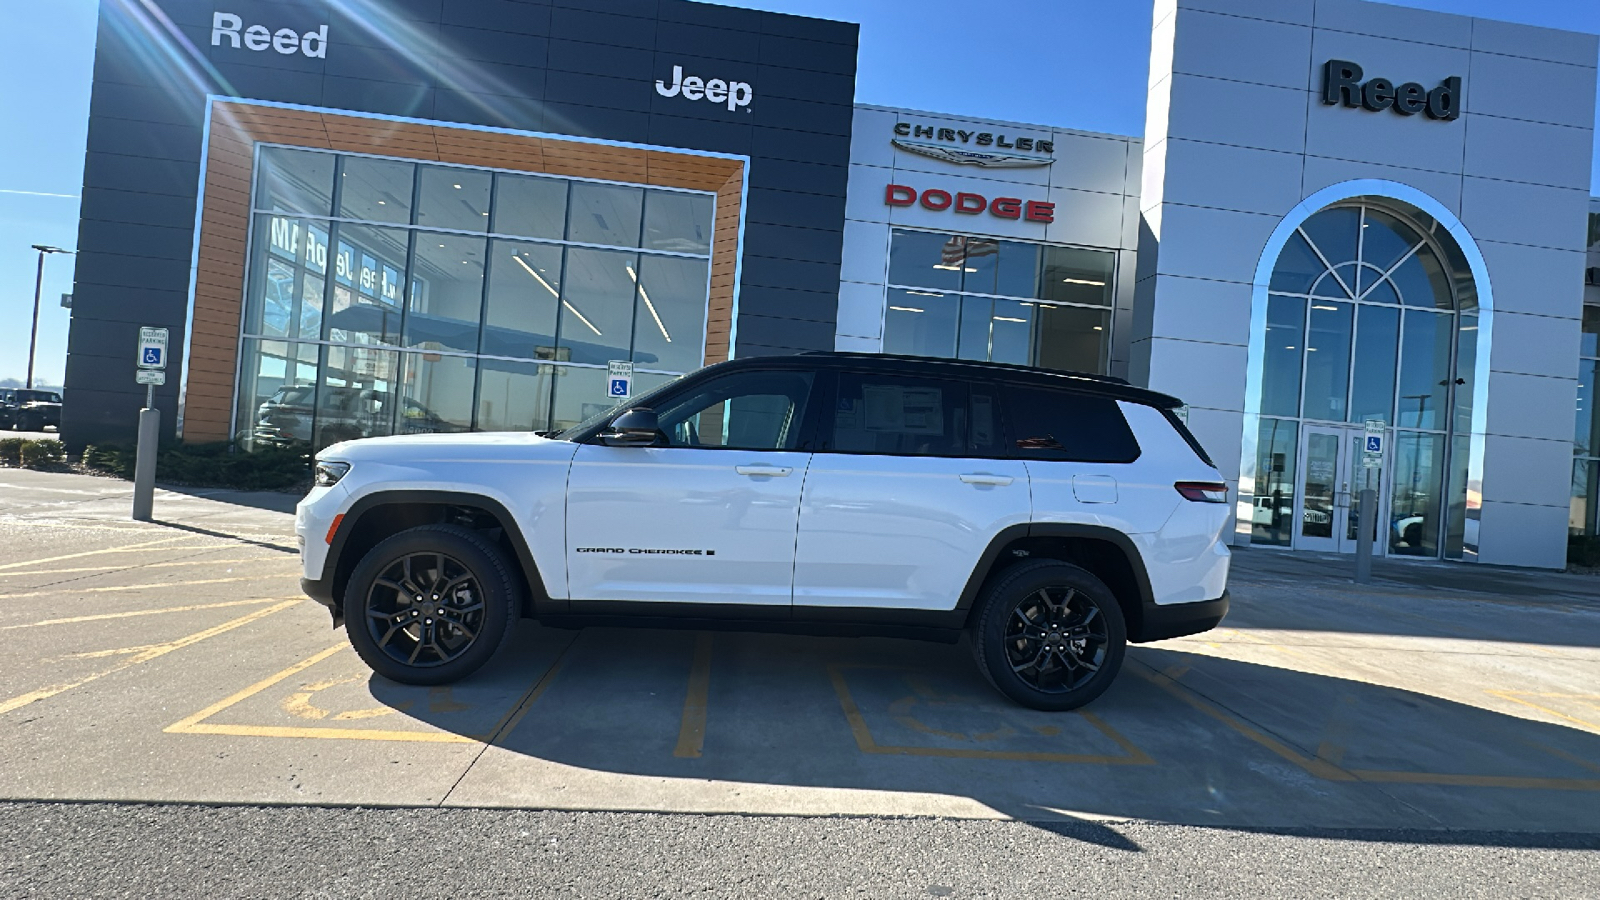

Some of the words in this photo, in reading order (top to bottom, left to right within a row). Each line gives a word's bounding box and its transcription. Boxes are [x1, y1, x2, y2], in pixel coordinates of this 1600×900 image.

[211, 11, 328, 59] Reed
[655, 65, 753, 112] Jeep
[1323, 59, 1461, 121] Reed
[893, 122, 1054, 153] CHRYSLER
[885, 183, 1056, 223] DODGE
[628, 548, 703, 556] CHEROKEE
